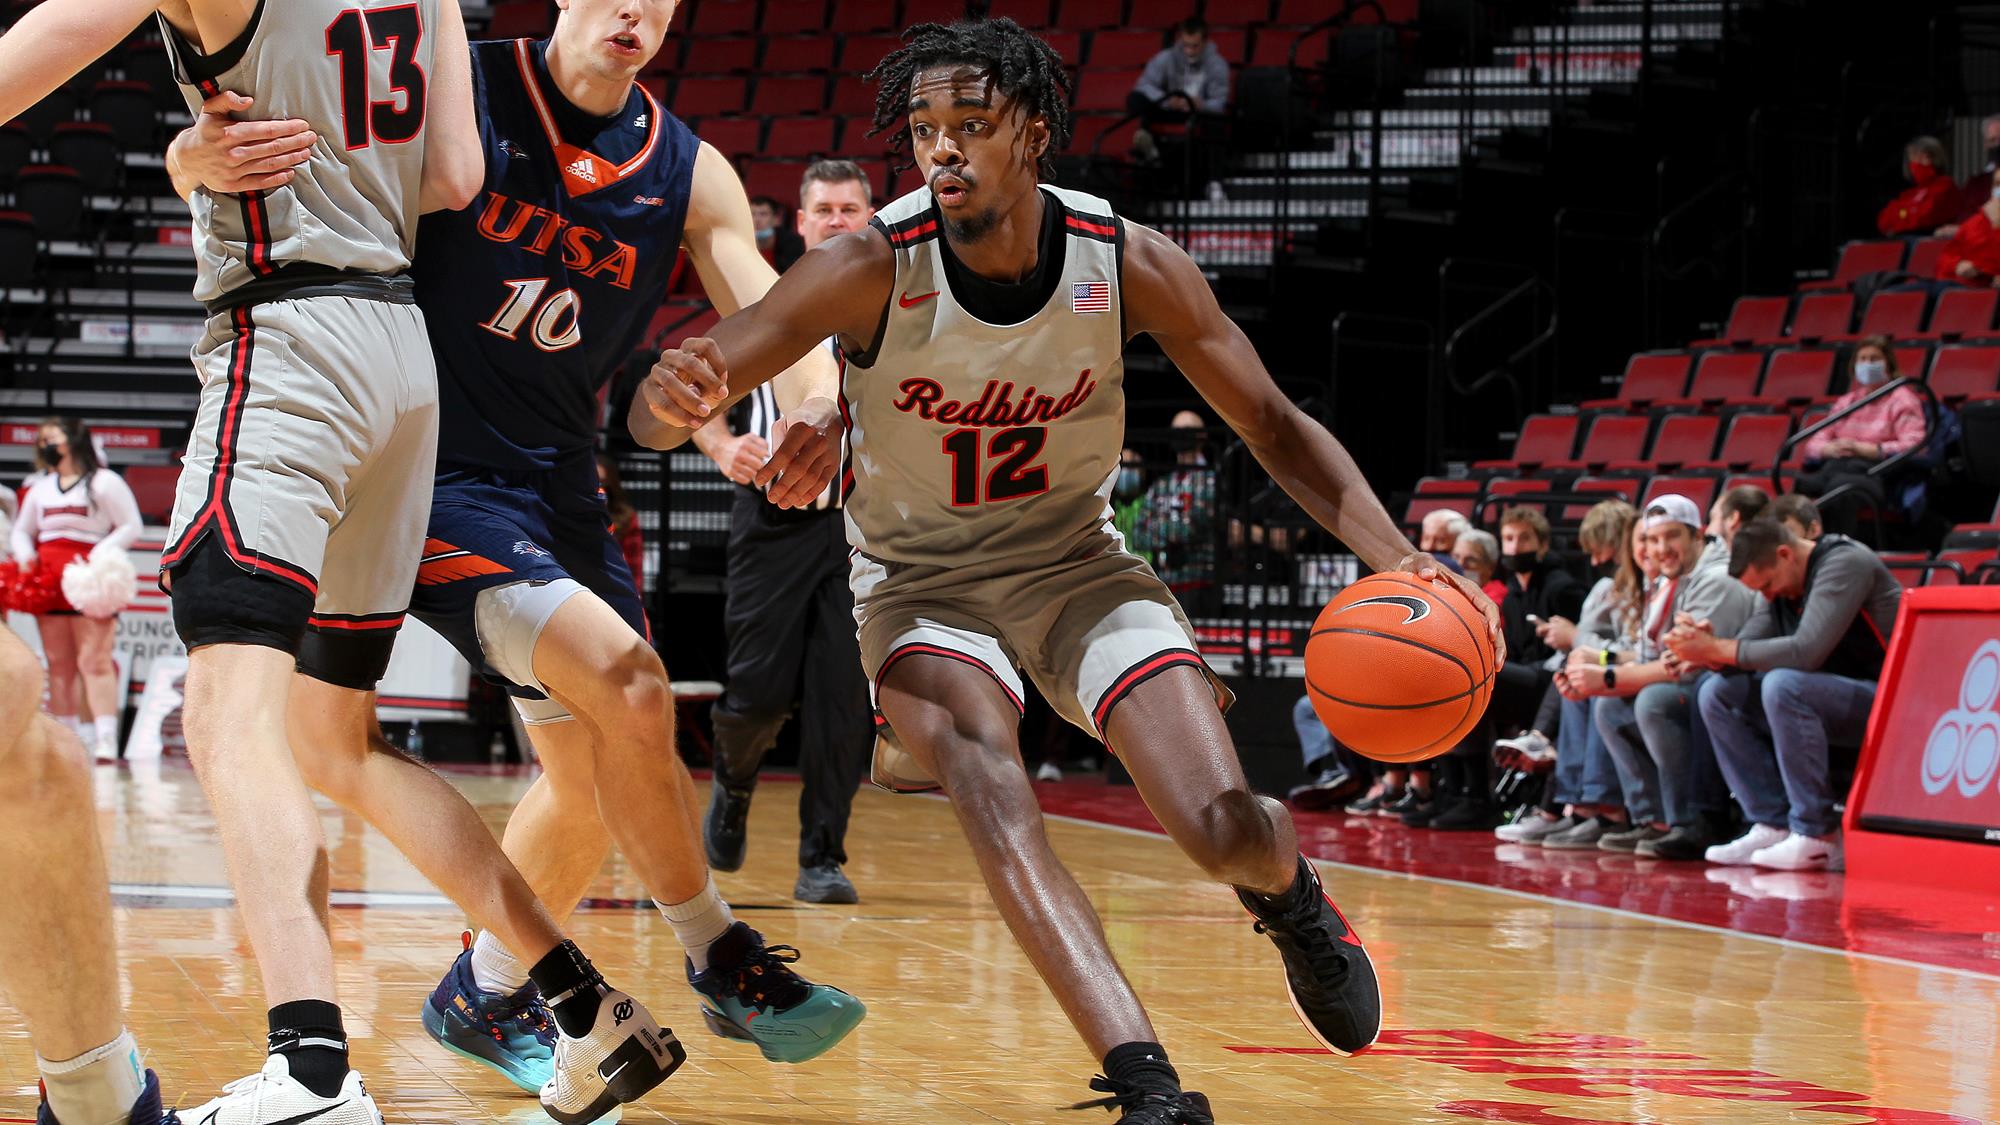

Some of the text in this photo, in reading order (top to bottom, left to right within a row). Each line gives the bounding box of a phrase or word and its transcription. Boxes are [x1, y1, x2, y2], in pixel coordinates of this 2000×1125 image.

[325, 3, 426, 151] 13
[565, 166, 597, 184] adidas
[476, 191, 637, 290] UTSA
[478, 277, 582, 352] 10
[942, 427, 1050, 507] 12
[113, 641, 186, 660] ERICA
